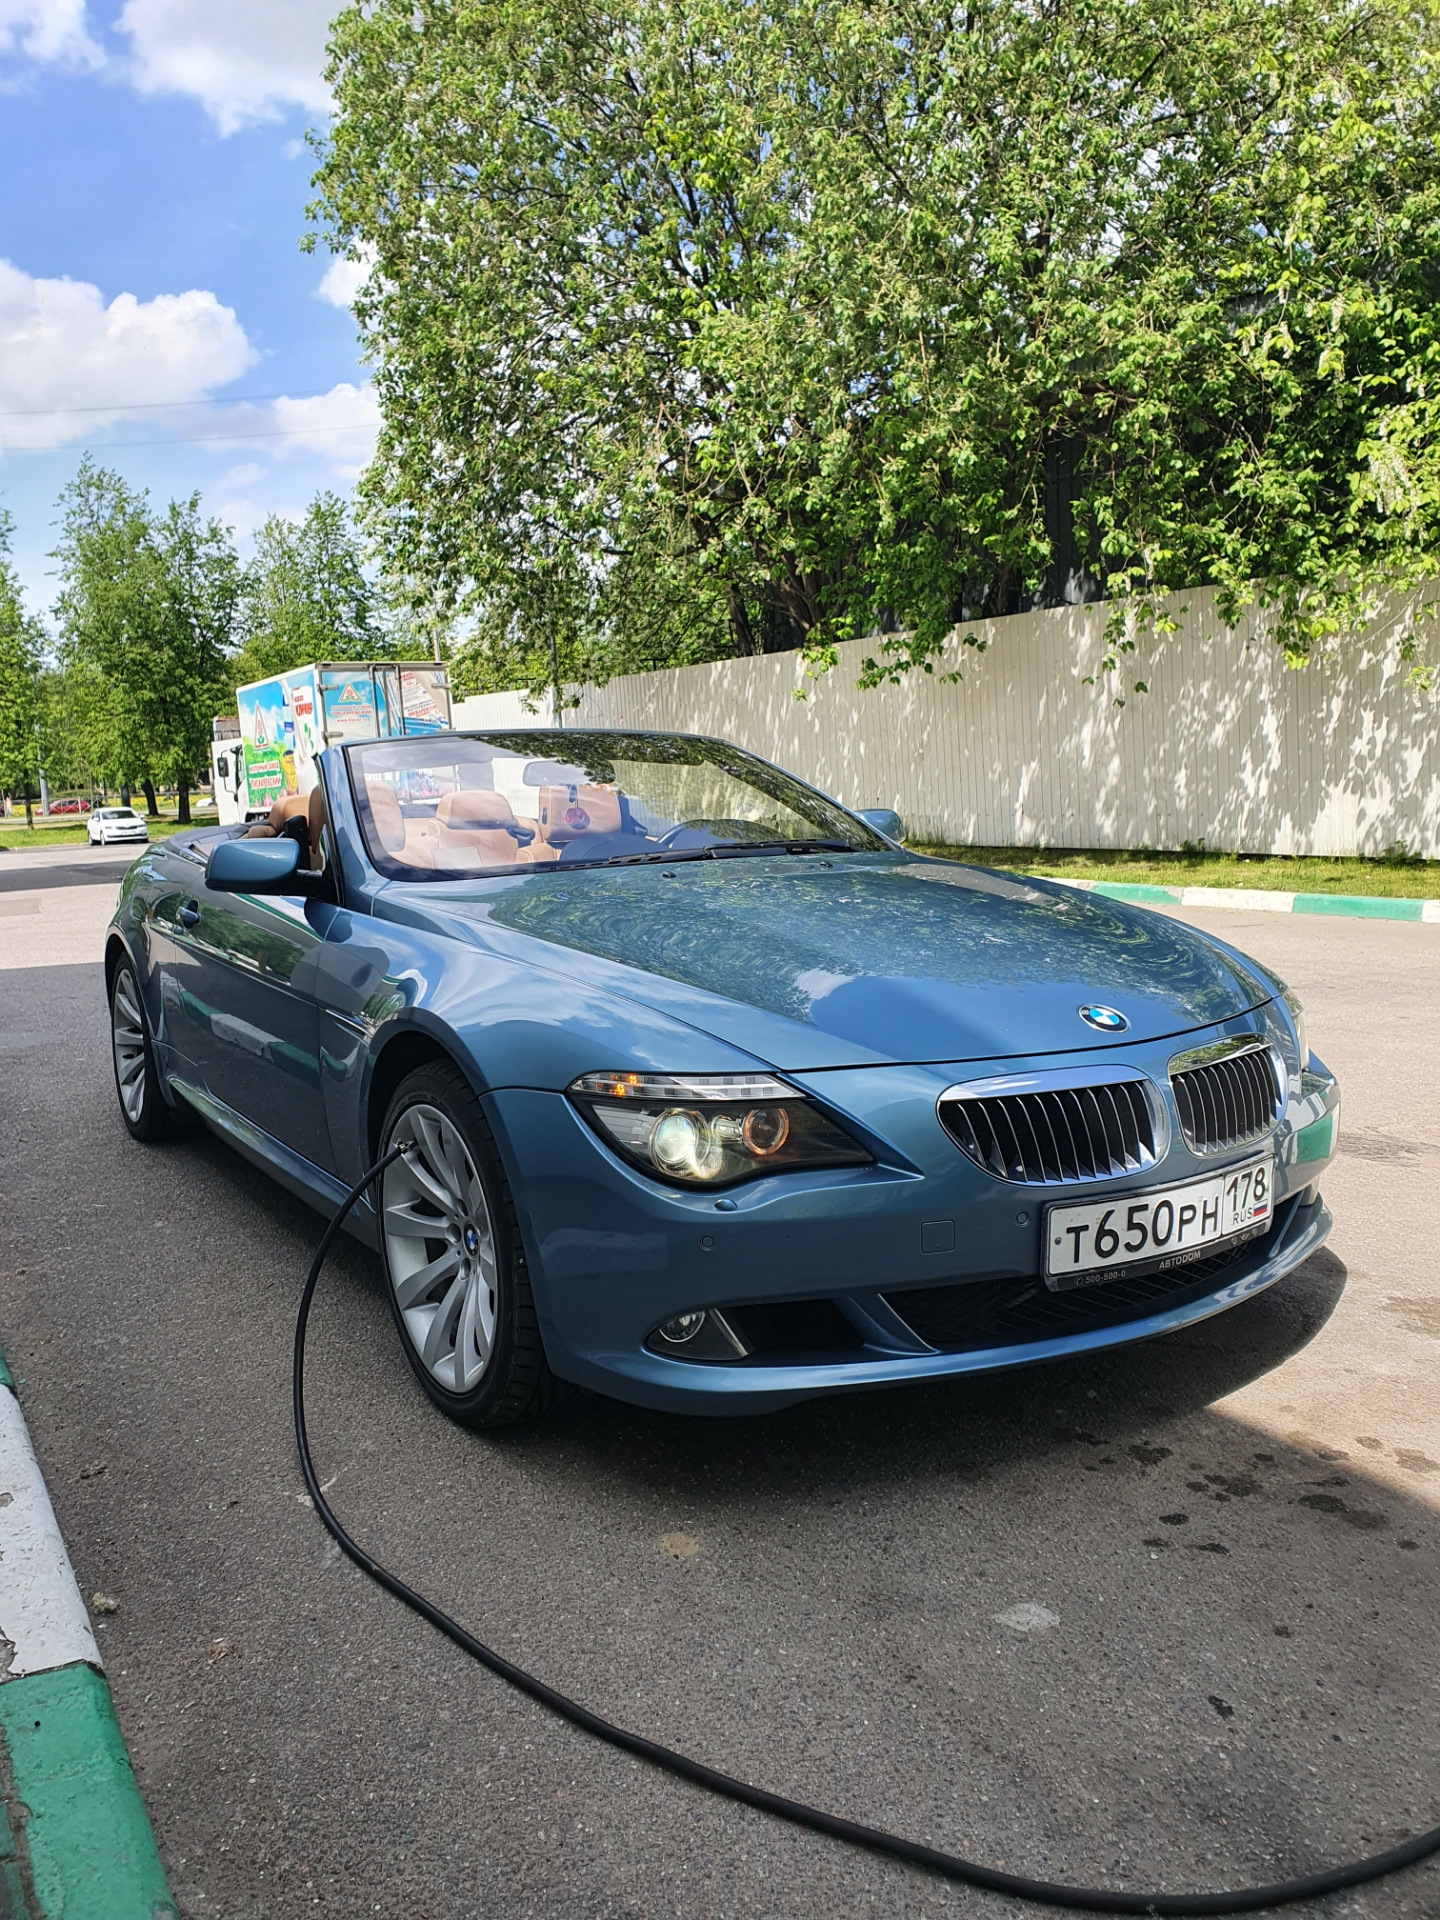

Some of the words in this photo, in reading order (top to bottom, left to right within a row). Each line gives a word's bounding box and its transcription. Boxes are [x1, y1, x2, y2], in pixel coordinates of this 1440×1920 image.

[1066, 1195, 1219, 1264] Т650РН
[1226, 1166, 1266, 1212] 178
[1233, 1206, 1253, 1226] RUS
[1085, 1269, 1126, 1285] 500-500-0
